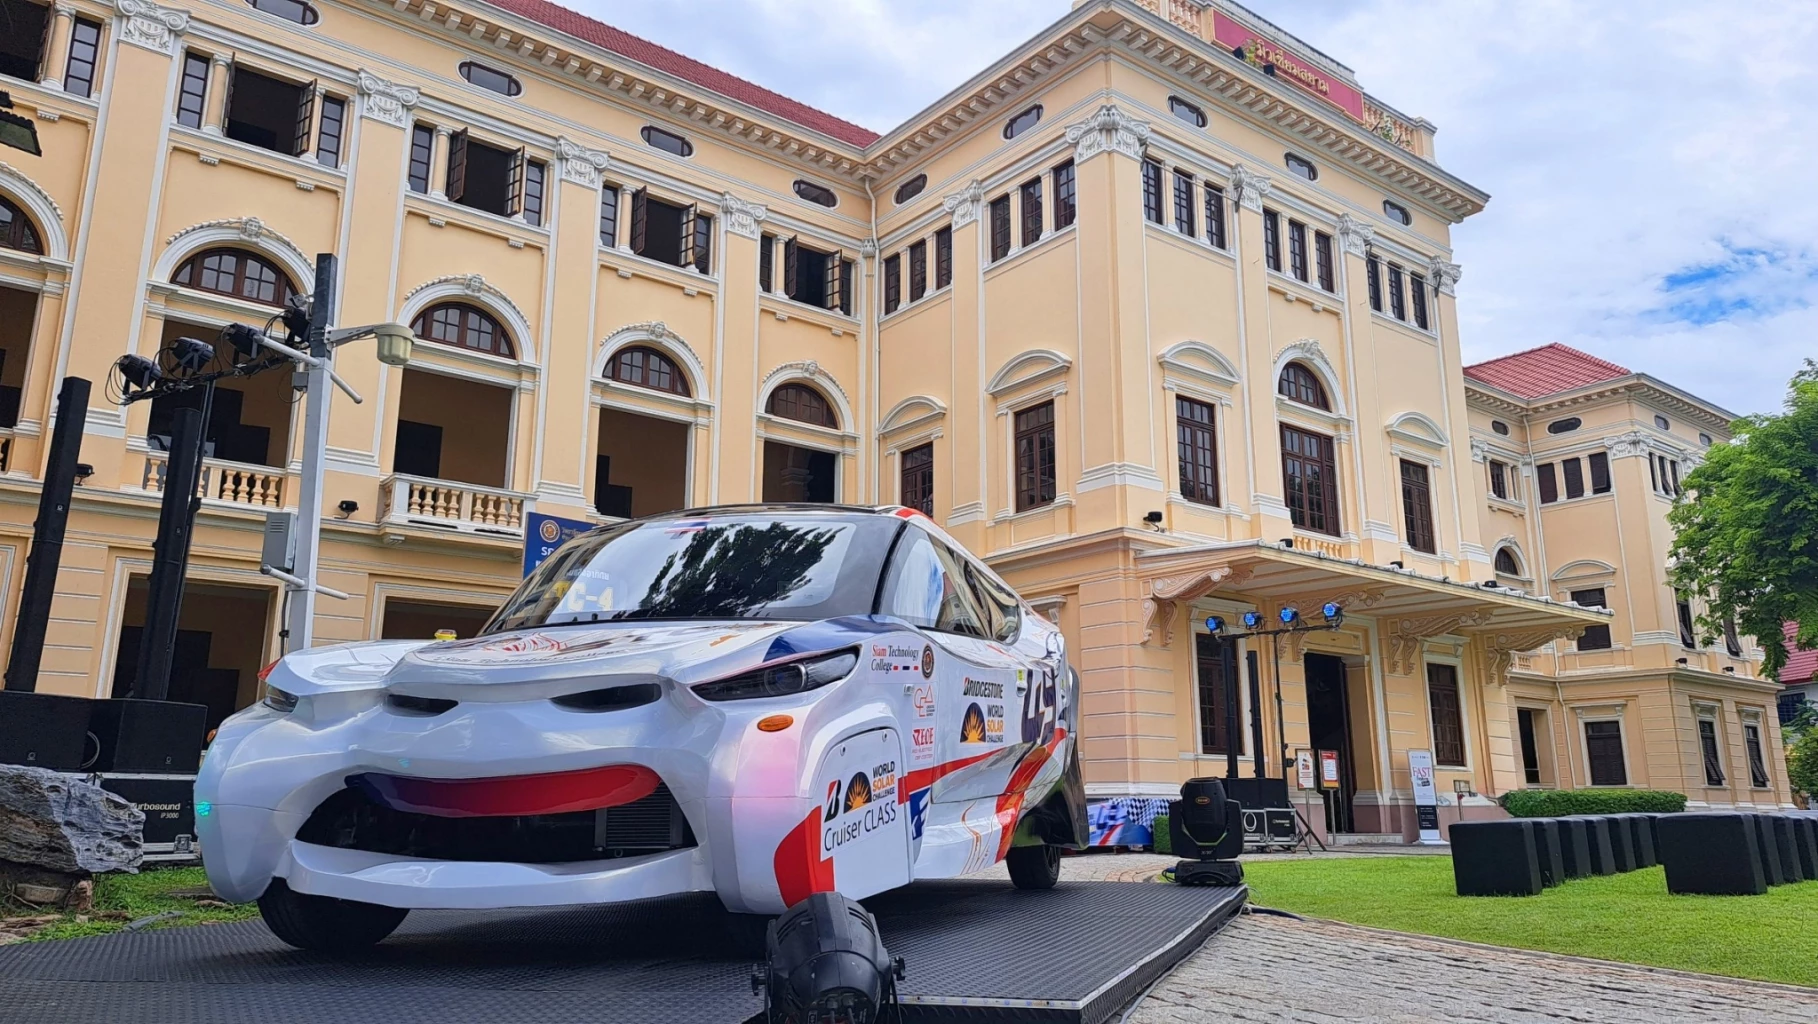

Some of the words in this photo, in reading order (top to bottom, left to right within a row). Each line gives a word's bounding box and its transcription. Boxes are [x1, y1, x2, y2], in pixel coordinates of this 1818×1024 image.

[872, 644, 887, 657] Siam
[888, 645, 919, 662] Technology
[871, 658, 893, 674] College
[963, 677, 1004, 699] BRIDGESTONE
[987, 704, 1004, 718] WORLD
[987, 719, 1004, 733] SOLAR
[987, 734, 1004, 743] CHALLENGE
[873, 761, 895, 778] WORLD
[1412, 766, 1431, 777] FAST
[872, 774, 895, 792] SOLAR
[872, 787, 895, 802] CHALLENGE
[138, 802, 180, 810] urbosound
[824, 820, 862, 852] Cruiser
[864, 800, 896, 832] CLASS
